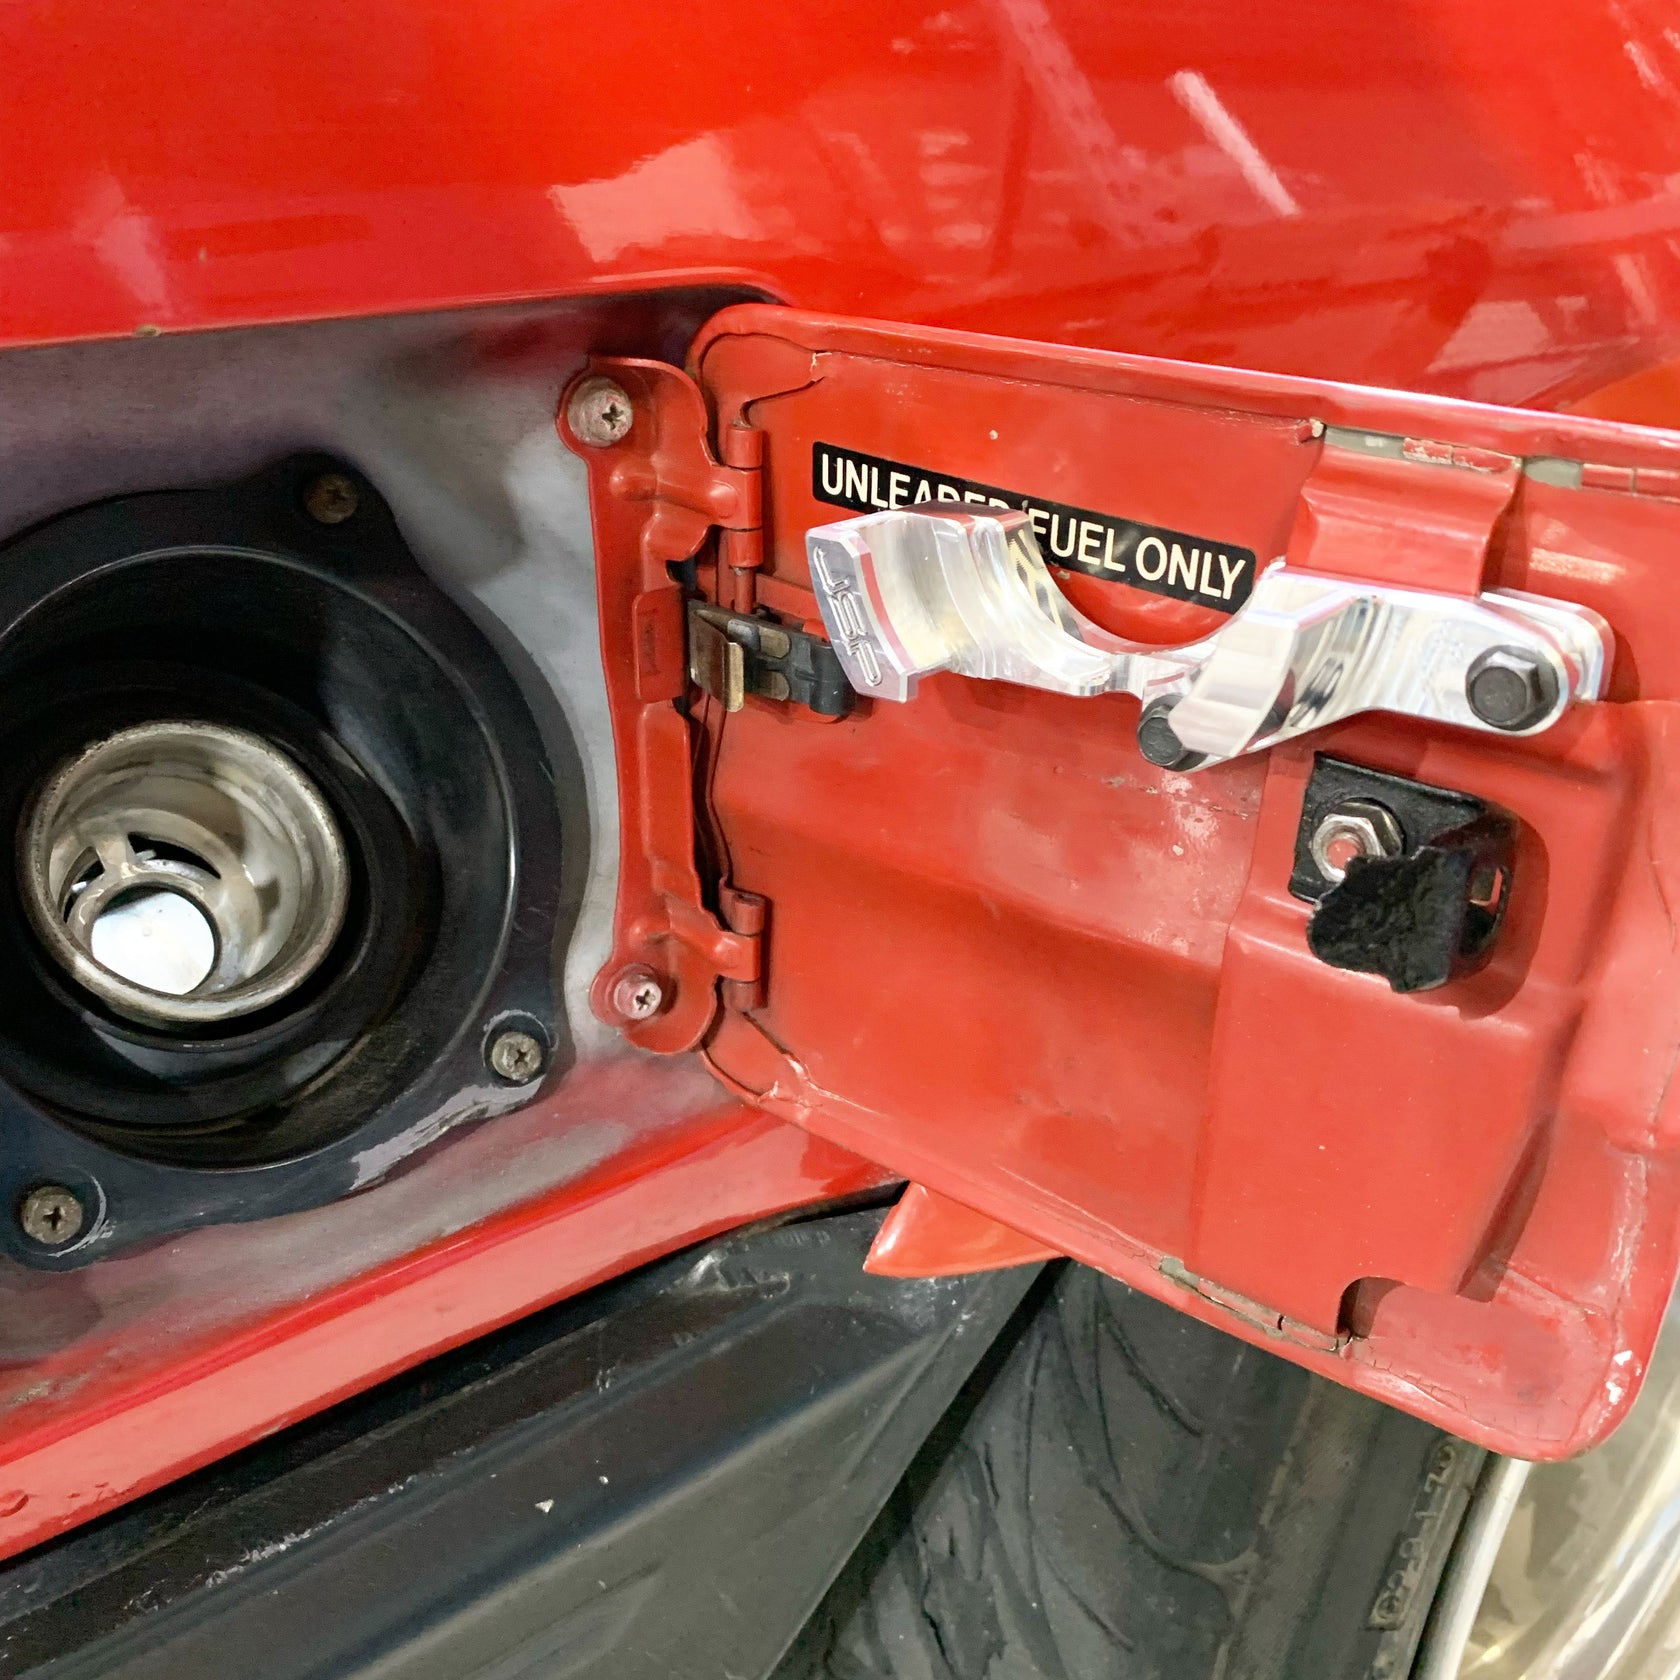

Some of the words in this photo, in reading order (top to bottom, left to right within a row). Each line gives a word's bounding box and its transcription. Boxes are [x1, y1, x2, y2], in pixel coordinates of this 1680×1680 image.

[821, 453, 1010, 511] UNLEA
[1028, 508, 1126, 573] FUEL
[1135, 536, 1247, 600] ONLY
